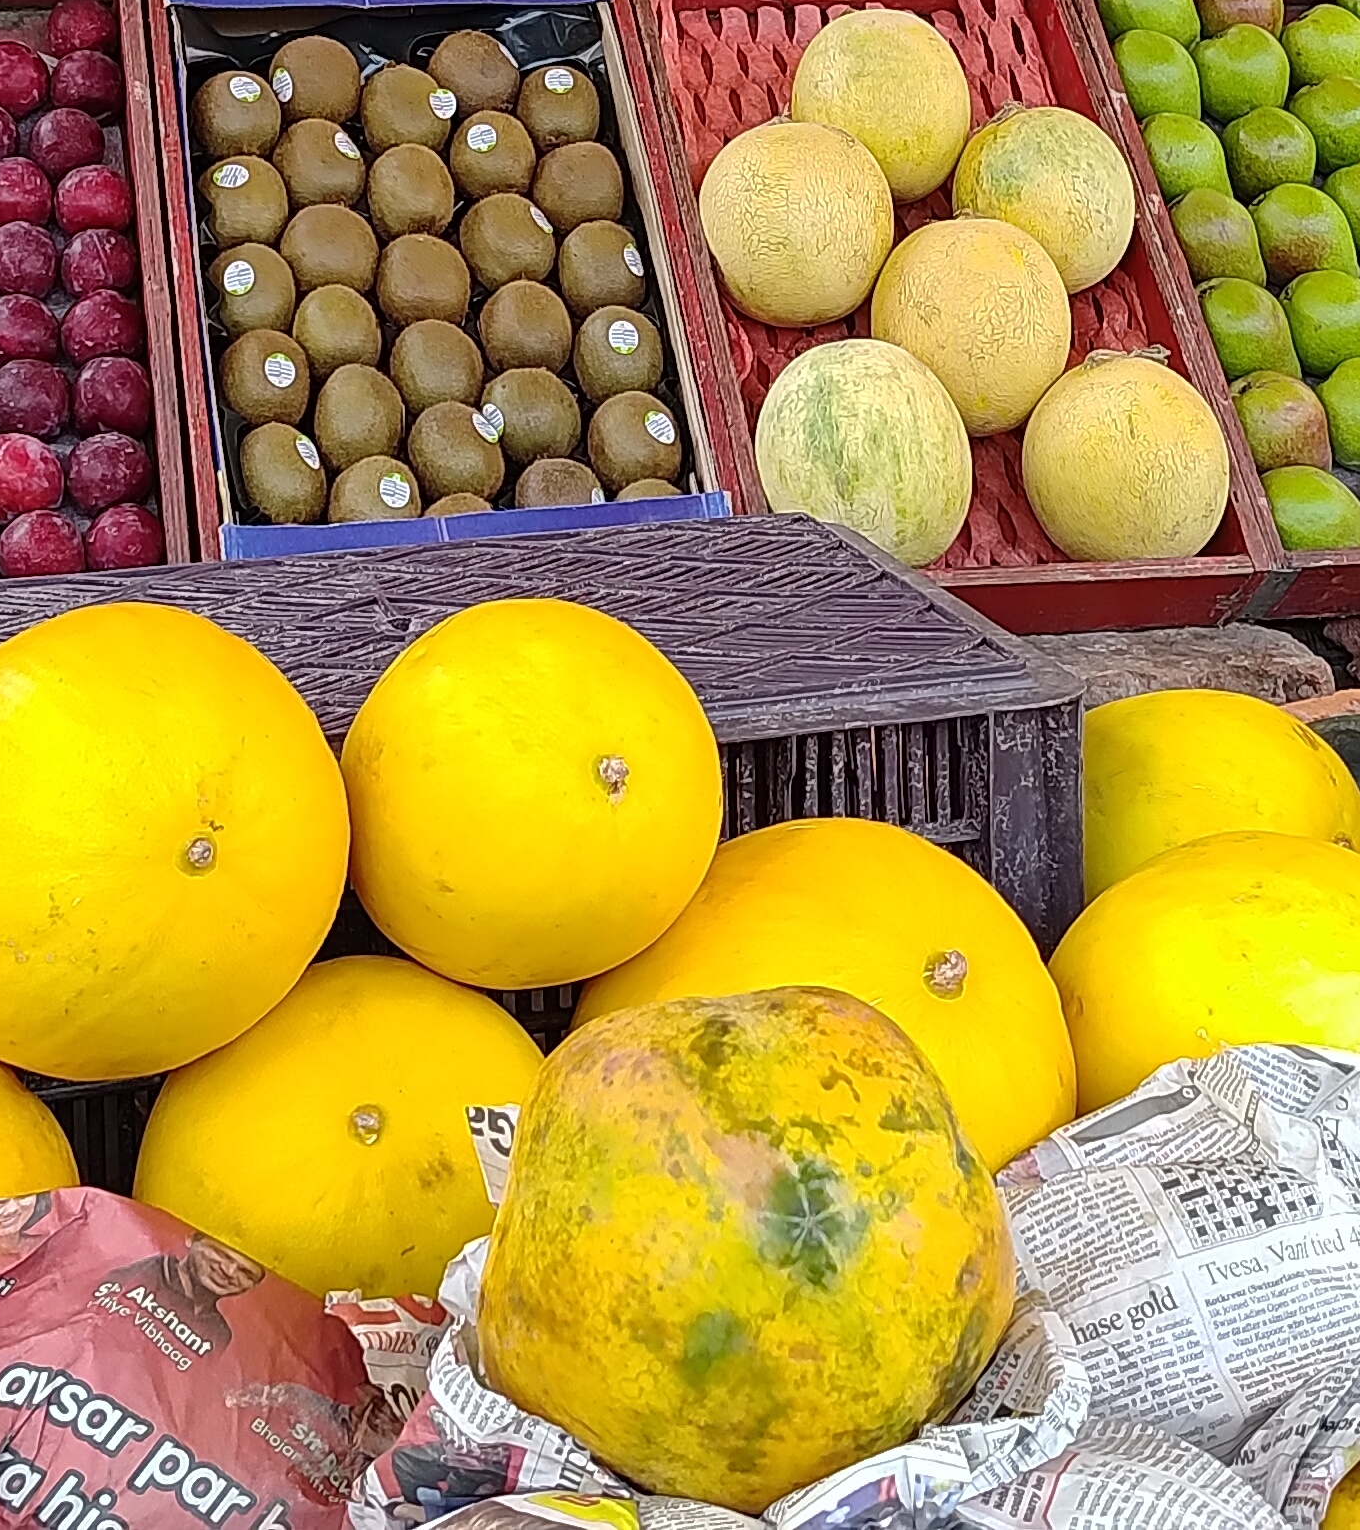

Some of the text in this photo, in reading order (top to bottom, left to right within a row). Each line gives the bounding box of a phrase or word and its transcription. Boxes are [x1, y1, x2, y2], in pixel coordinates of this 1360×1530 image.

[1083, 1142, 1107, 1156] Across
[1028, 1238, 1053, 1254] which
[1198, 1228, 1345, 1289] Tvesa, Vani tied
[1123, 1285, 1180, 1330] gold
[1212, 1314, 1236, 1328] Swiss
[1237, 1306, 1266, 1320] Ladies
[1266, 1299, 1289, 1312] Open
[126, 1286, 215, 1358] Akshant
[1154, 1314, 1192, 1334] domestic
[133, 1310, 194, 1373] Vibhaag
[357, 1330, 419, 1355] TIMES
[1117, 1345, 1145, 1360] March
[969, 1380, 994, 1412] EURO
[985, 1390, 999, 1405] IS
[1150, 1371, 1213, 1399] Portland Track
[132, 1436, 257, 1528] par
